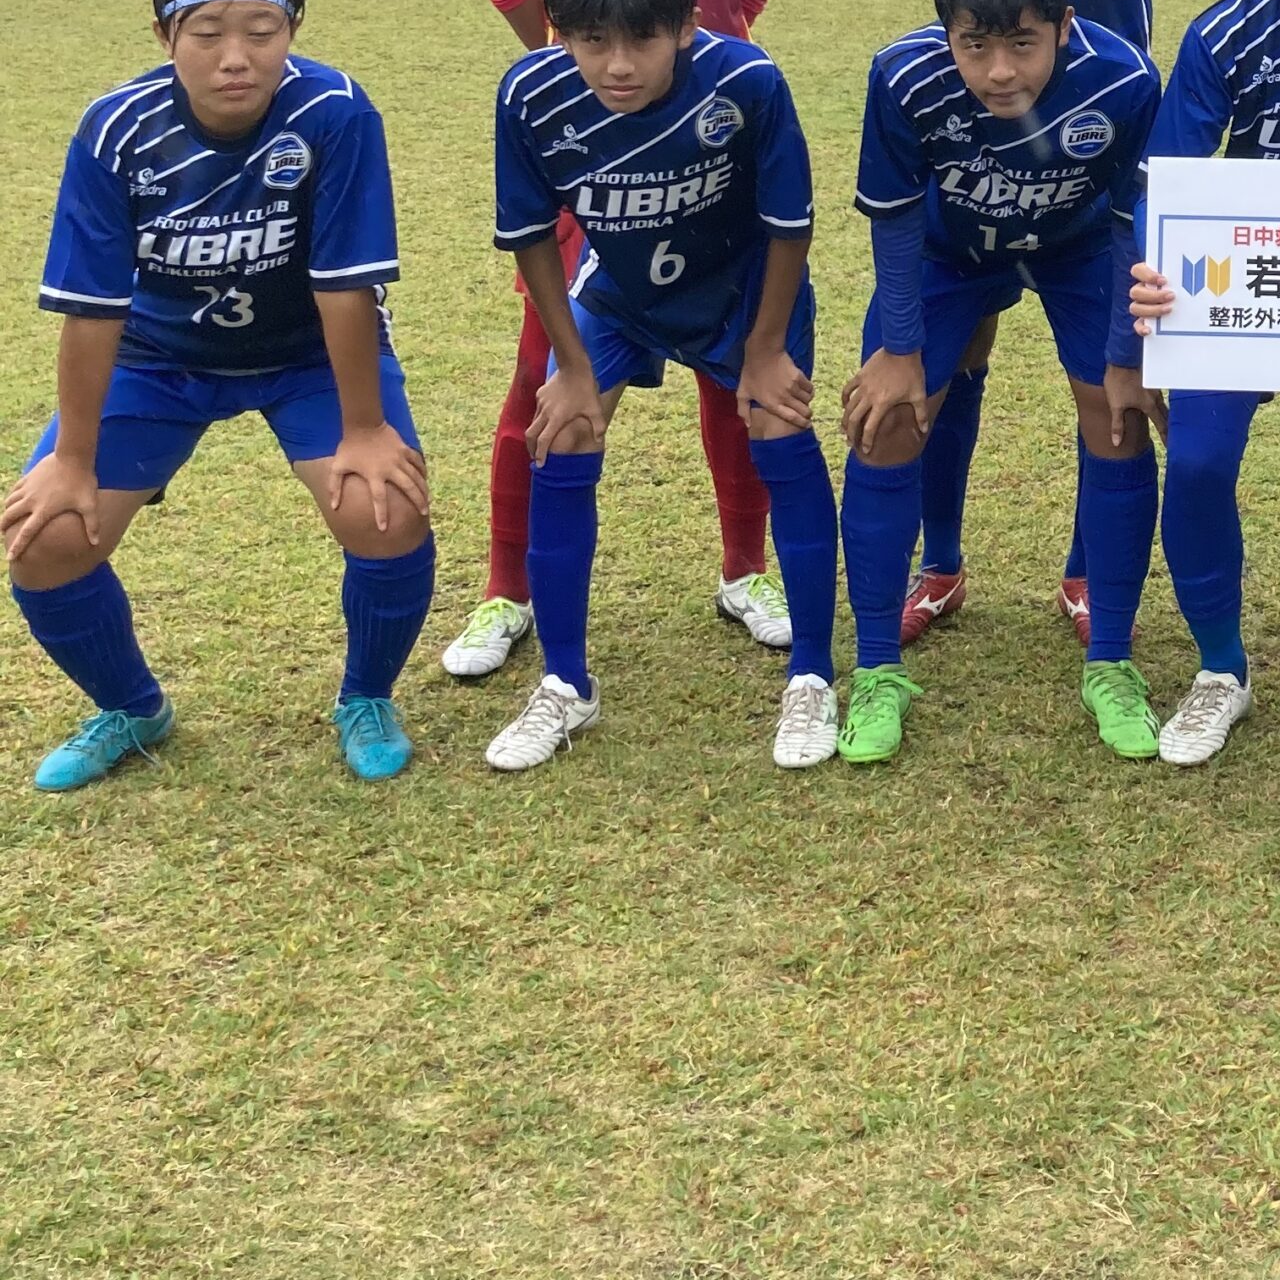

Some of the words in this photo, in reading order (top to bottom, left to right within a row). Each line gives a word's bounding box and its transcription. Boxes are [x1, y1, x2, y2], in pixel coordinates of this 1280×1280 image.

[1067, 130, 1108, 144] LIBRE
[267, 154, 305, 173] LIBRE
[586, 171, 678, 186] FOOTBALL
[684, 152, 729, 176] CLUB
[1040, 166, 1087, 180] CLUB
[575, 162, 734, 218] LIBRE
[940, 168, 1091, 210] LIBRE
[154, 211, 242, 231] FOOTBALL
[245, 200, 290, 222] CLUB
[586, 215, 674, 233] FUKUOKA
[682, 193, 723, 217] 2016
[946, 195, 1024, 219] FUKUOKA
[137, 216, 298, 266] LIBRE
[978, 224, 1043, 251] 14
[148, 262, 237, 277] FUKUOKA
[244, 253, 290, 276] 2016
[650, 239, 686, 286] 6
